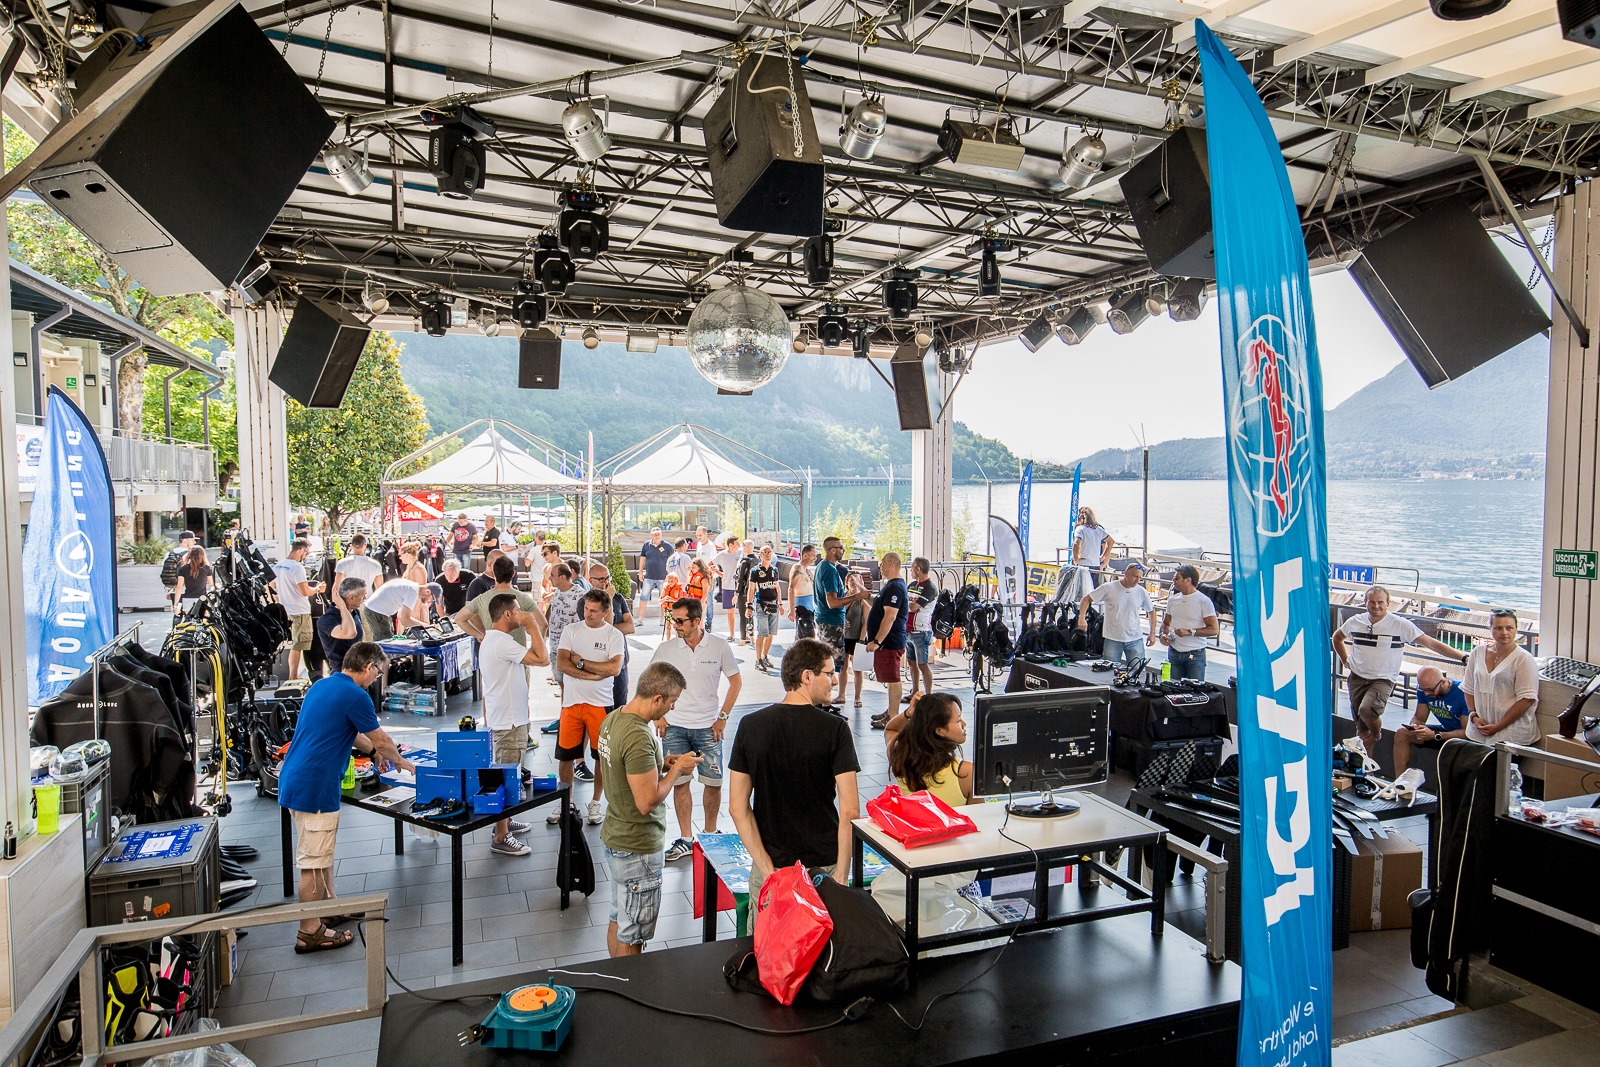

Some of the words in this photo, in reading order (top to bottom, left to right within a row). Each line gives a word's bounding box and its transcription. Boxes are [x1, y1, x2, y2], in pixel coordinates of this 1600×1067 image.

[401, 511, 422, 519] DAN
[1555, 553, 1579, 564] USCITA
[1555, 564, 1578, 574] EMERGENZA
